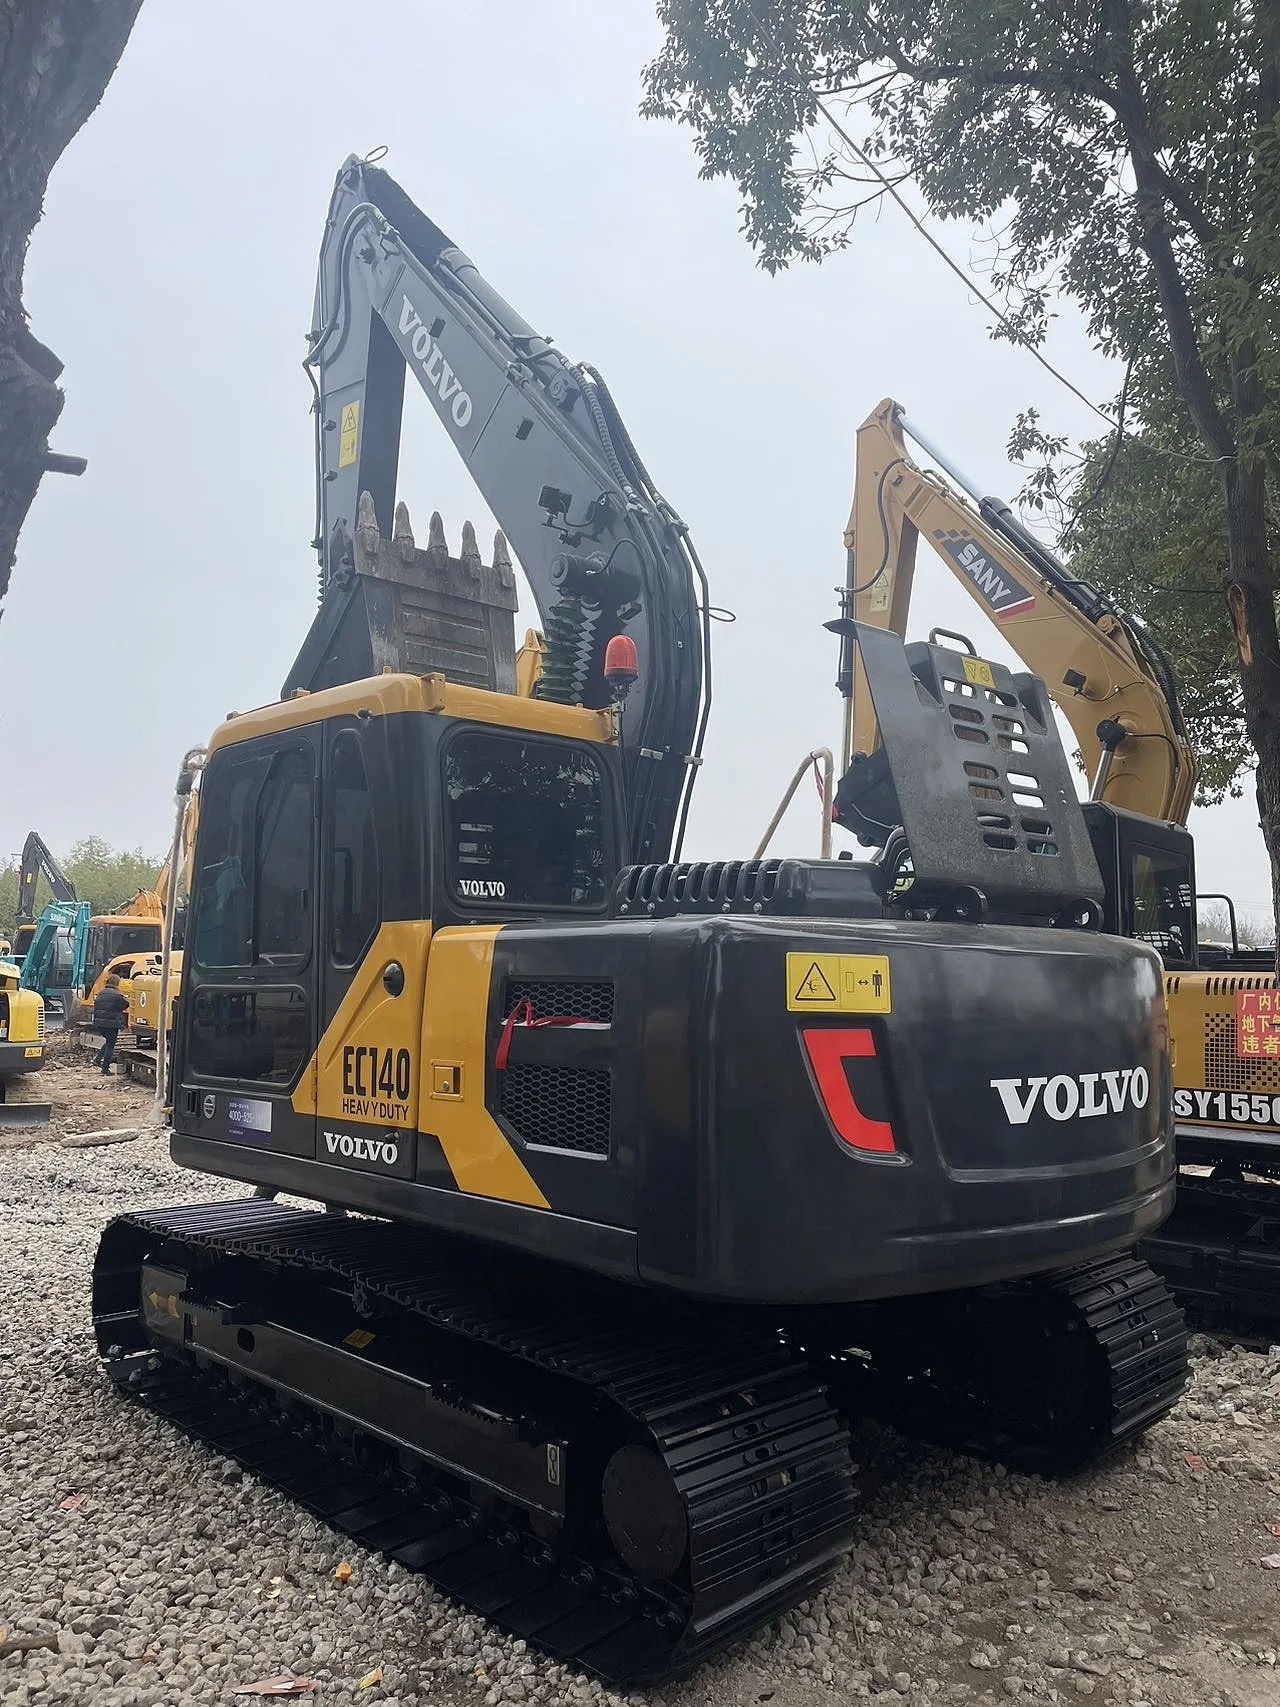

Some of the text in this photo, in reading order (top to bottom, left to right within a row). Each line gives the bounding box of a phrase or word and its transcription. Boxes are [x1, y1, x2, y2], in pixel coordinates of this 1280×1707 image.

[399, 294, 473, 427] VOLVO
[957, 543, 1012, 602] SANY
[459, 879, 506, 897] VOLVO
[1241, 1034, 1280, 1054] 违者
[343, 1045, 411, 1101] EC140
[990, 1066, 1150, 1125] VOLVO
[323, 1131, 399, 1165] VOLVO
